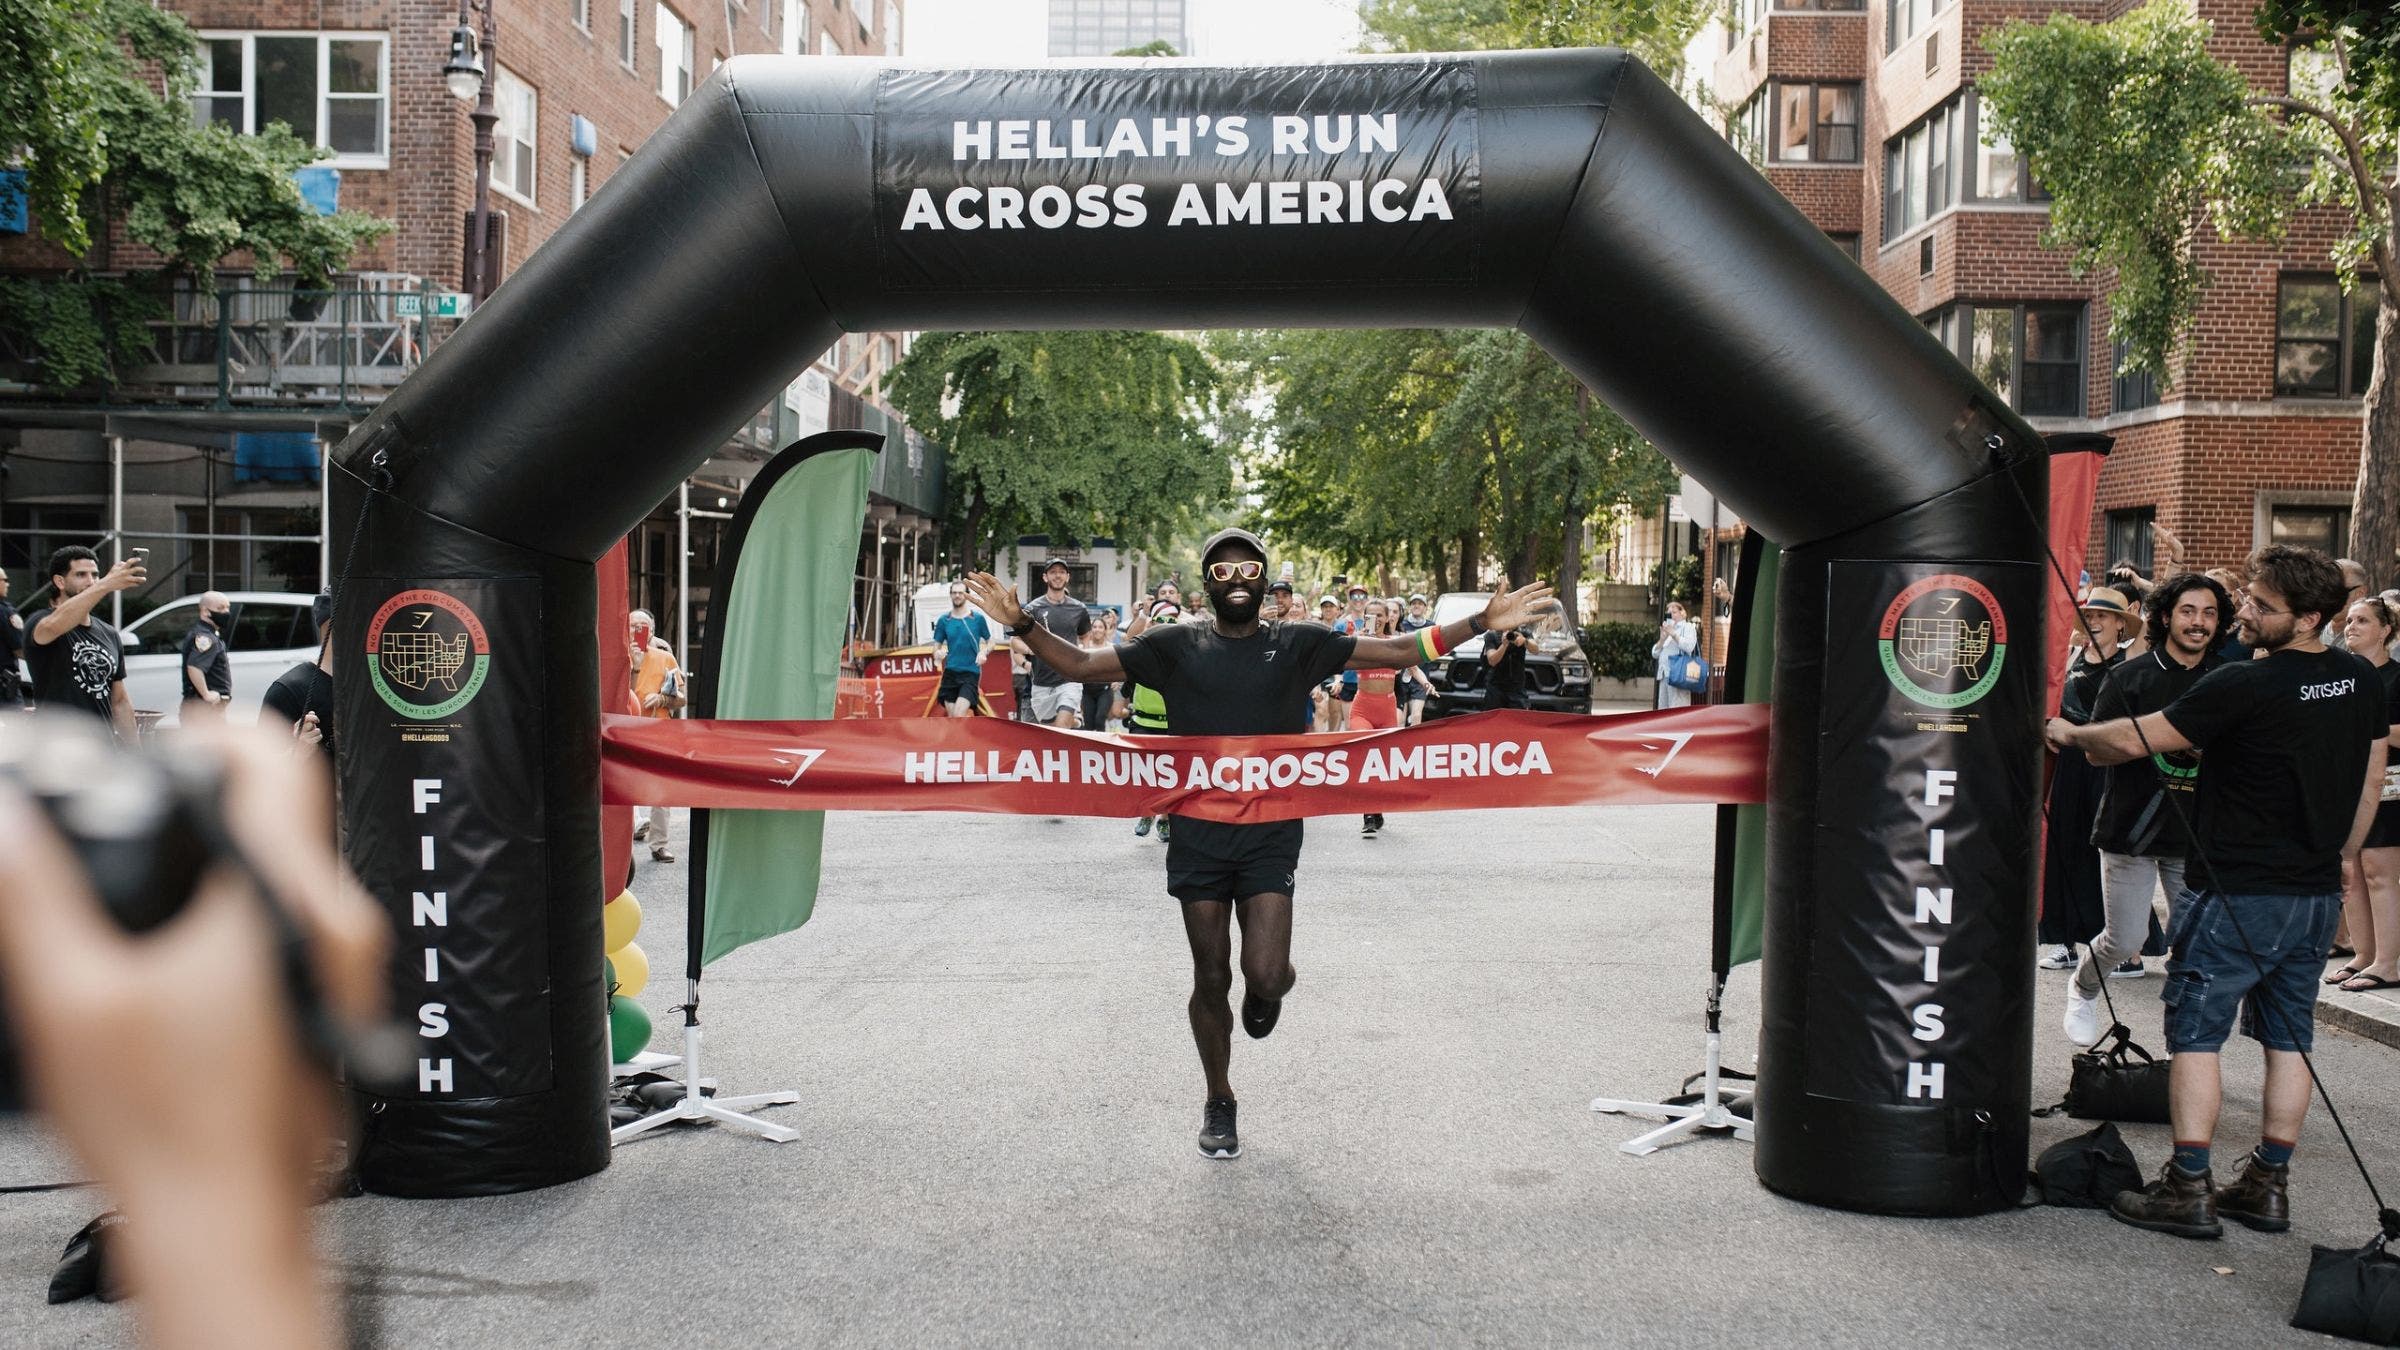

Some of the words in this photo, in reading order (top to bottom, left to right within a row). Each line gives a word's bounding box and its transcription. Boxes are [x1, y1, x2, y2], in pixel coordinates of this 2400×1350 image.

[953, 115, 1250, 161] HELLAH'S
[1272, 112, 1398, 155] RUN
[900, 183, 1147, 230] ACROSS
[1167, 177, 1454, 226] AMERICA
[373, 600, 399, 631] MATTER
[400, 593, 418, 603] THE
[422, 593, 486, 649] CIRCUMSTANCES
[370, 634, 377, 648] NO
[1885, 620, 1893, 633] NO
[371, 659, 393, 699] QUELQUES
[393, 699, 419, 714] SOIENT
[422, 705, 437, 715] LES
[440, 660, 486, 712] CIRCONSTANCES
[880, 657, 934, 675] CLEAN
[2299, 678, 2355, 701] SATIS&FY
[904, 750, 1070, 784] HELLAH
[1080, 750, 1179, 789] RUNS
[1184, 750, 1350, 792] ACROSS
[1358, 741, 1553, 784] AMERICA
[412, 779, 453, 1092] FINISH
[1907, 769, 1957, 1099] FINISH
